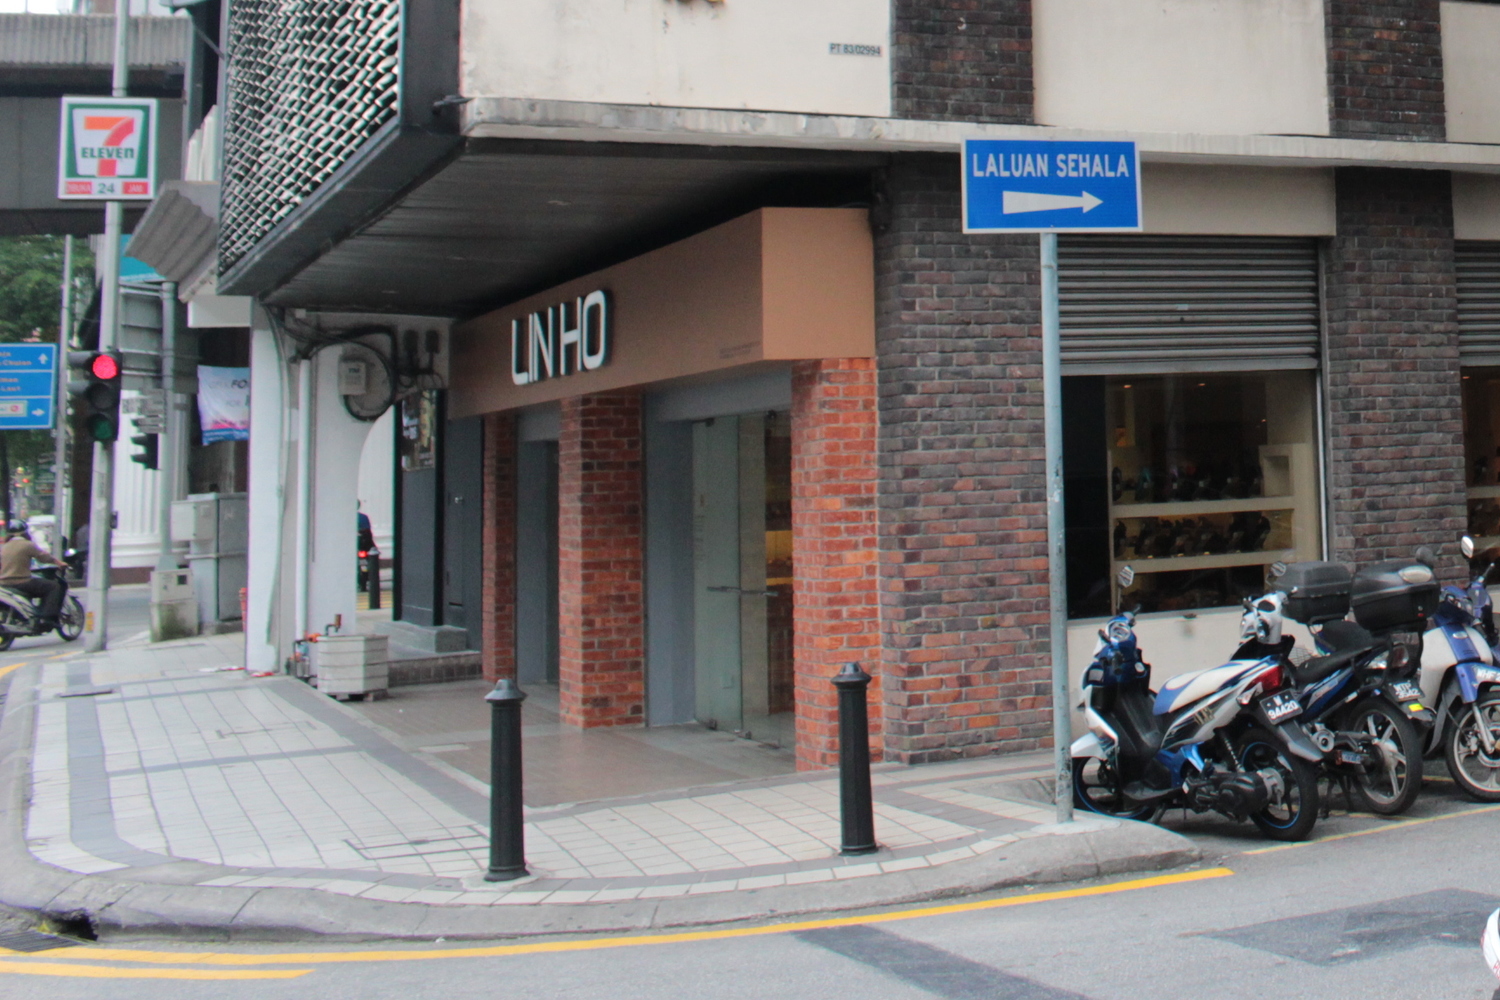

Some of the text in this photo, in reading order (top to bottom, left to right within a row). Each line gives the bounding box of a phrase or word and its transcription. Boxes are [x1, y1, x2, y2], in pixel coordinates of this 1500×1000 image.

[829, 42, 841, 53] PT
[84, 115, 135, 177] 7
[973, 153, 1129, 178] LALUAN SEHALA
[97, 183, 115, 194] 24
[511, 289, 606, 386] LIN HO
[1475, 667, 1496, 680] WHF
